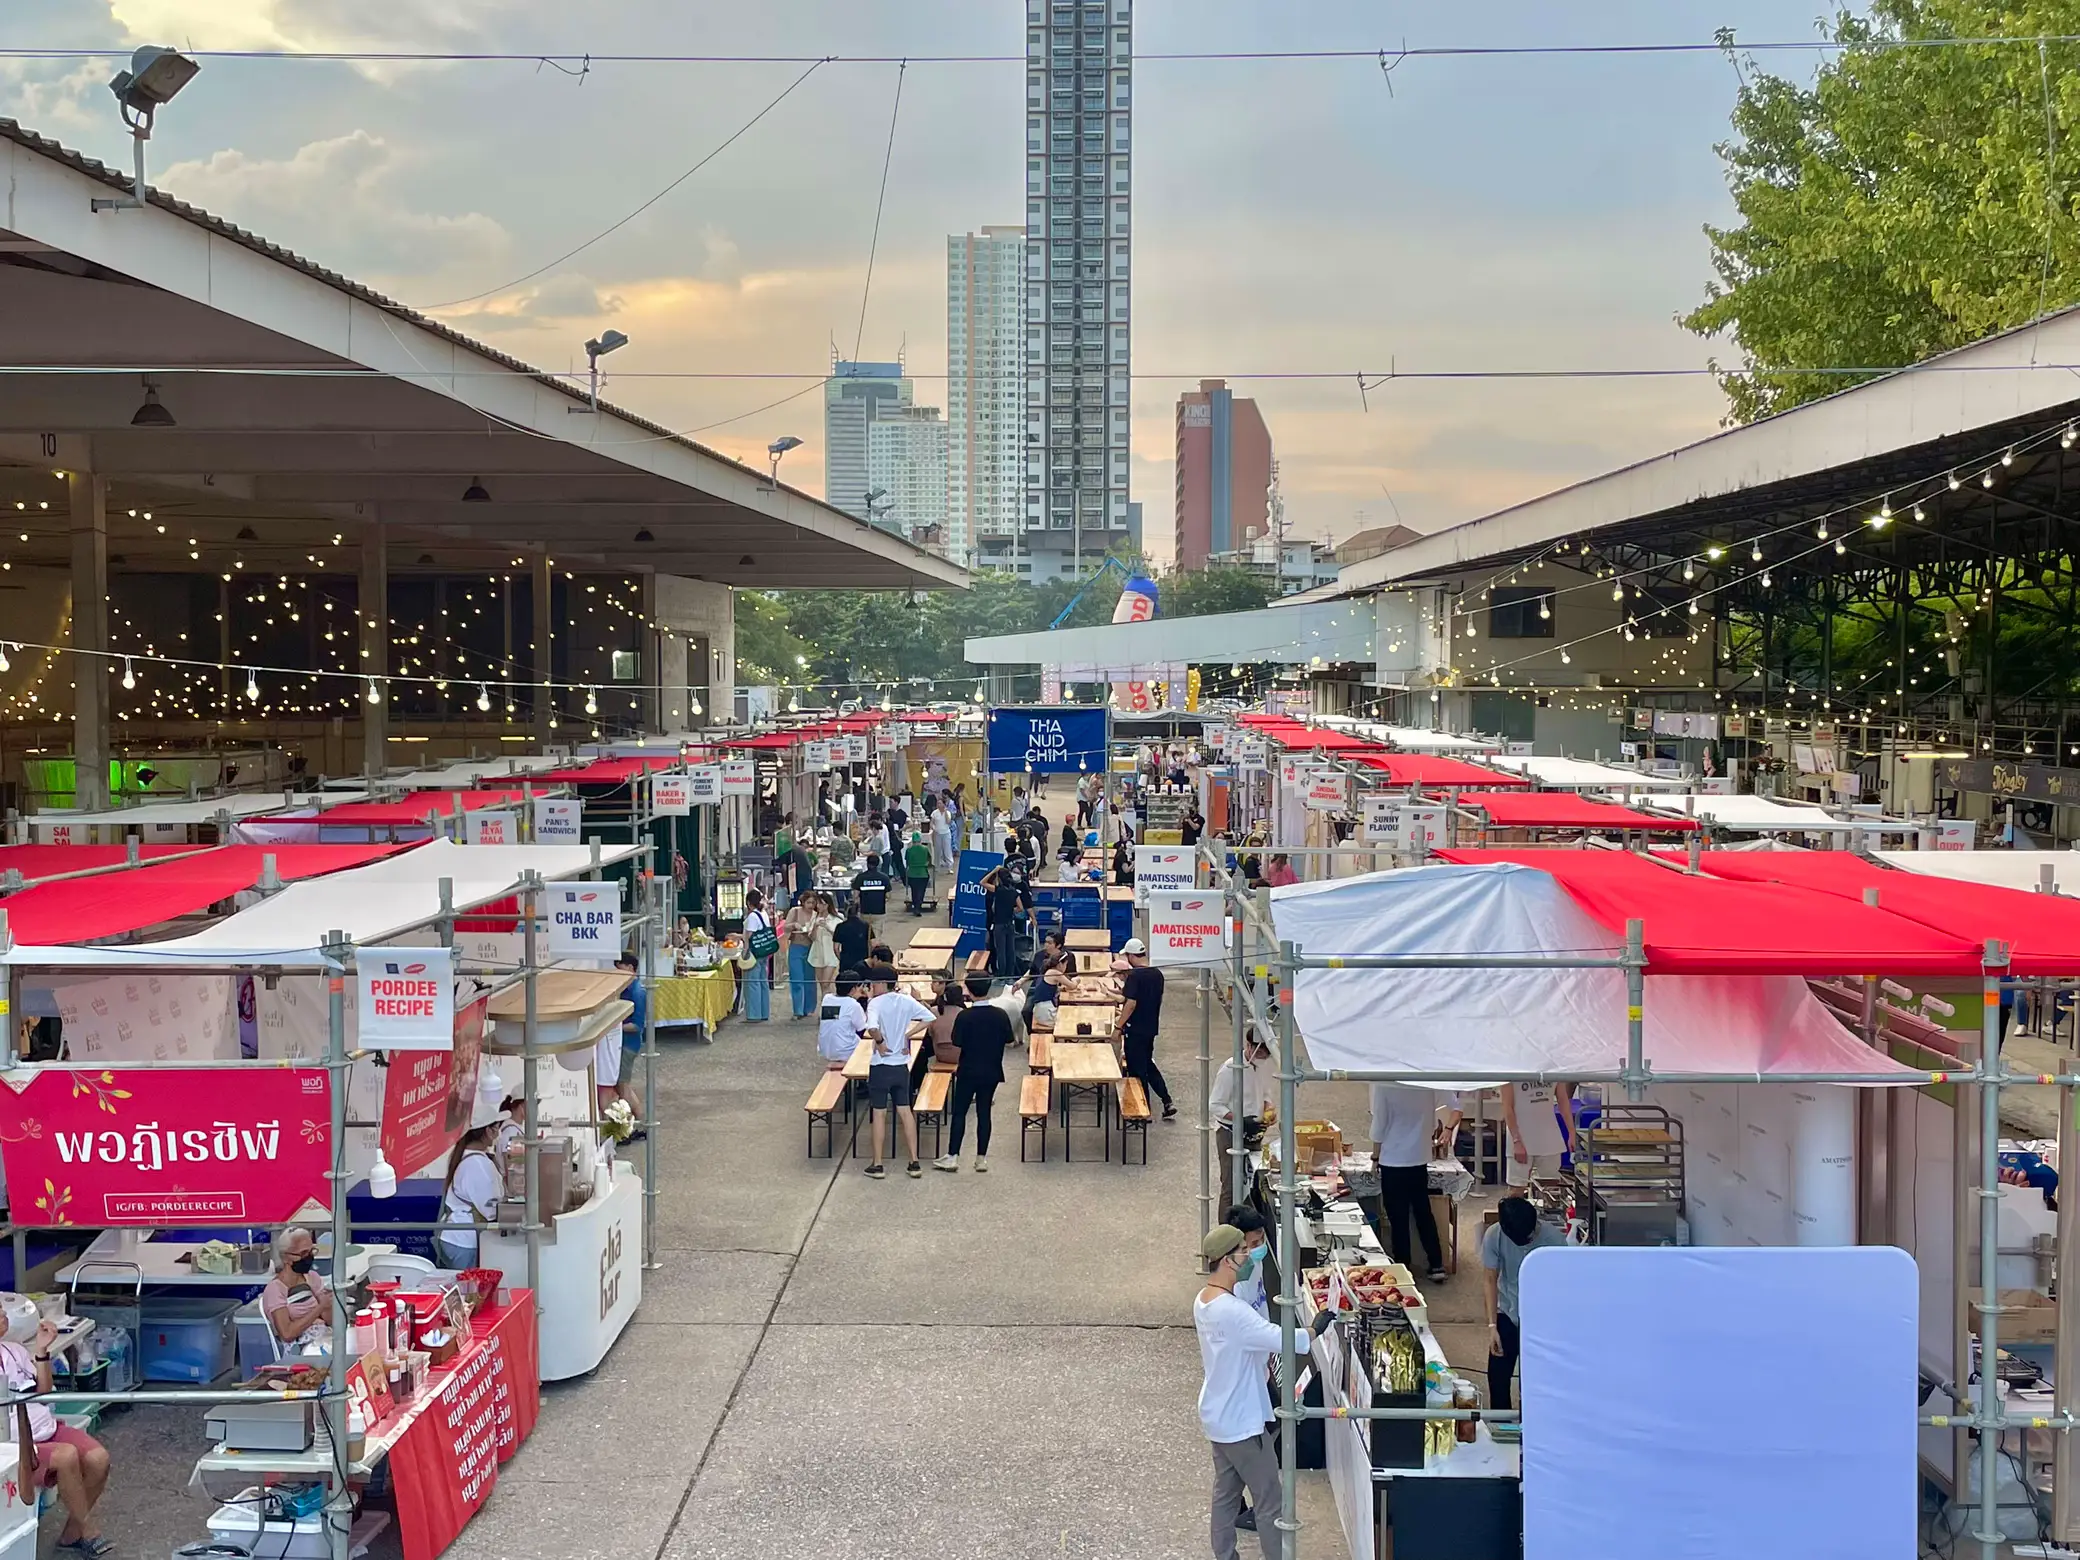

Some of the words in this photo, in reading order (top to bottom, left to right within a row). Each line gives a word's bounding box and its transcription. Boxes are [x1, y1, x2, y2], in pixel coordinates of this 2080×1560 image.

[40, 433, 57, 457] 10
[1030, 719, 1062, 733] THA
[1029, 734, 1065, 748] NUD
[1025, 749, 1068, 762] CHIM
[545, 818, 570, 826] PANI'S
[53, 826, 70, 837] SAI
[480, 836, 504, 844] MALA
[1137, 873, 1193, 883] AMATISSIMO
[555, 912, 584, 925] CHA
[586, 912, 613, 924] BAR
[571, 927, 599, 940] BKK
[1152, 924, 1220, 935] AMATISSIMO
[371, 980, 437, 996] PORDEE
[375, 999, 434, 1016] RECIPE
[115, 1202, 148, 1212] IG/FB:
[151, 1201, 233, 1212] PORDEERECIPE
